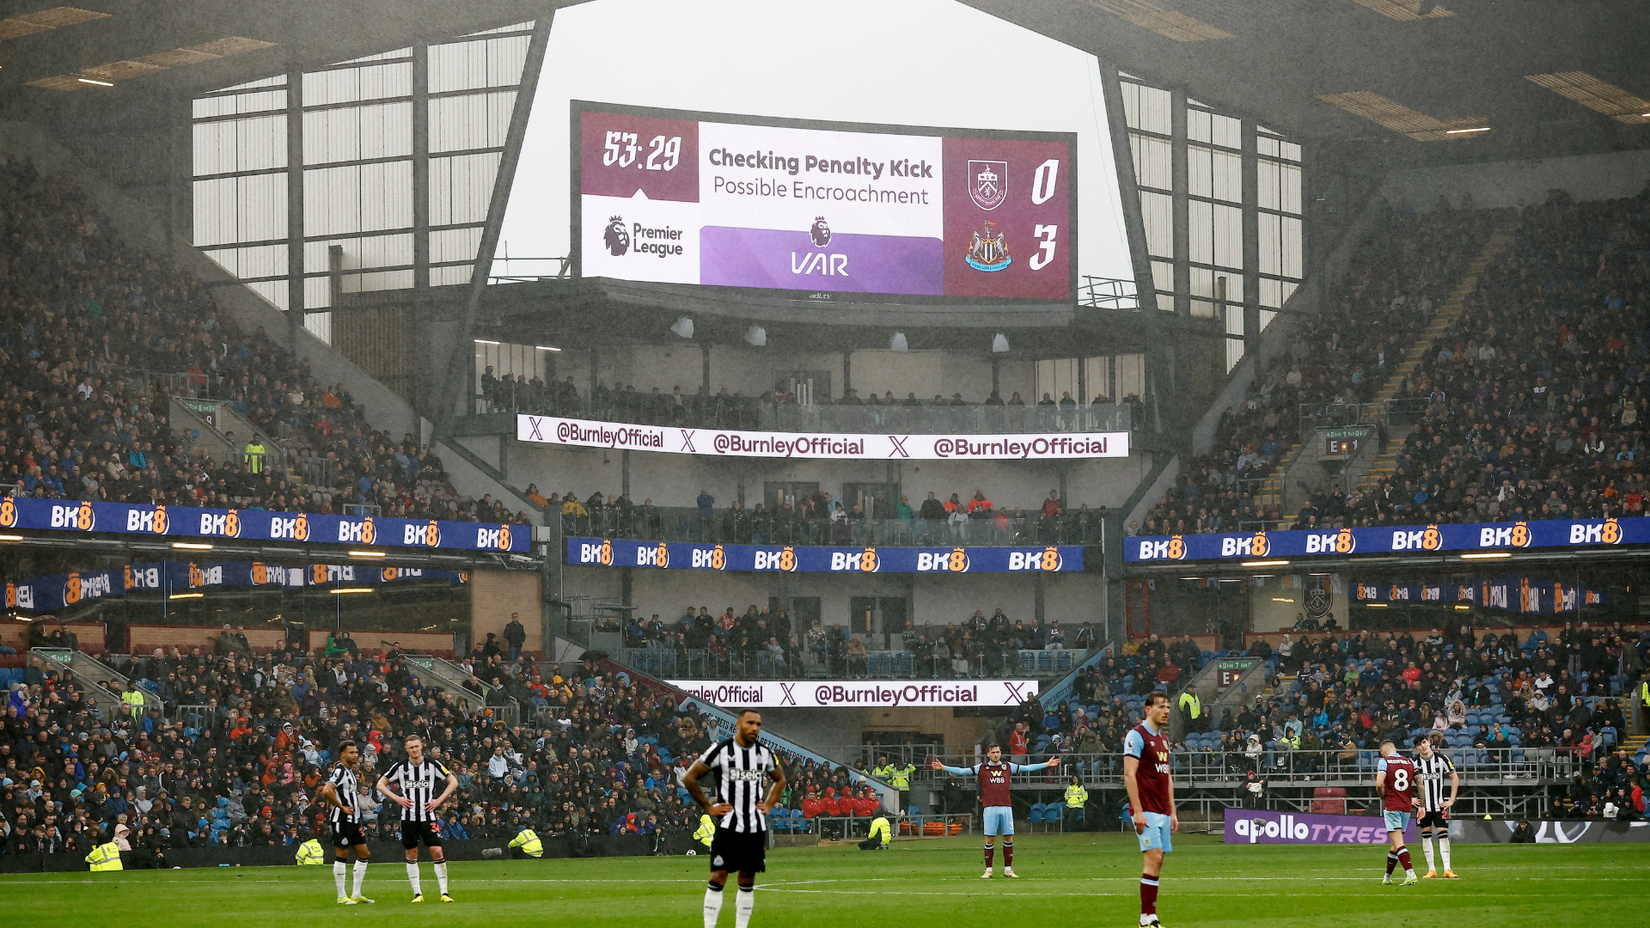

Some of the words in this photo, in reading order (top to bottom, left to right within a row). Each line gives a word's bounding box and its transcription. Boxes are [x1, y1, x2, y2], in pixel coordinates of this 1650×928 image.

[602, 131, 682, 172] 53:29
[709, 148, 799, 176] Checking
[805, 155, 885, 180] Penalty
[890, 159, 933, 179] Kick
[714, 176, 787, 198] Possible
[793, 181, 929, 205] Encroachment
[1031, 159, 1060, 205] 0
[633, 223, 683, 241] Premier
[633, 238, 683, 259] League
[1029, 224, 1058, 271] 3
[791, 251, 850, 277] VAR
[556, 421, 664, 449] @BurnleyOfficial
[713, 432, 864, 457] @BurnleyOfficial
[934, 437, 1108, 459] @BurnleyOfficial
[1330, 440, 1338, 453] E
[51, 504, 93, 531] BK8
[127, 507, 167, 534] BK8
[200, 511, 239, 538] BK8
[271, 514, 309, 541] BK8
[337, 517, 375, 544] BK8
[404, 521, 440, 547] BK8
[477, 524, 511, 550] BK8
[1139, 536, 1185, 560] BK8
[1222, 533, 1268, 556] BK8
[1306, 530, 1354, 553] BK8
[1392, 527, 1441, 550] BK8
[1480, 523, 1530, 547] BK8
[1570, 520, 1621, 544] BK8
[580, 541, 613, 566] BK8
[636, 544, 668, 568] BK8
[691, 546, 725, 570] BK8
[754, 547, 796, 571] BK8
[831, 548, 878, 571] BK8
[917, 548, 968, 571] BK8
[1009, 548, 1060, 571] BK8
[1223, 671, 1230, 685] E
[815, 685, 978, 706] @BurnleyOfficial
[1393, 768, 1409, 792] 8
[1234, 814, 1309, 844] apollo
[1311, 824, 1388, 844] TYRES
